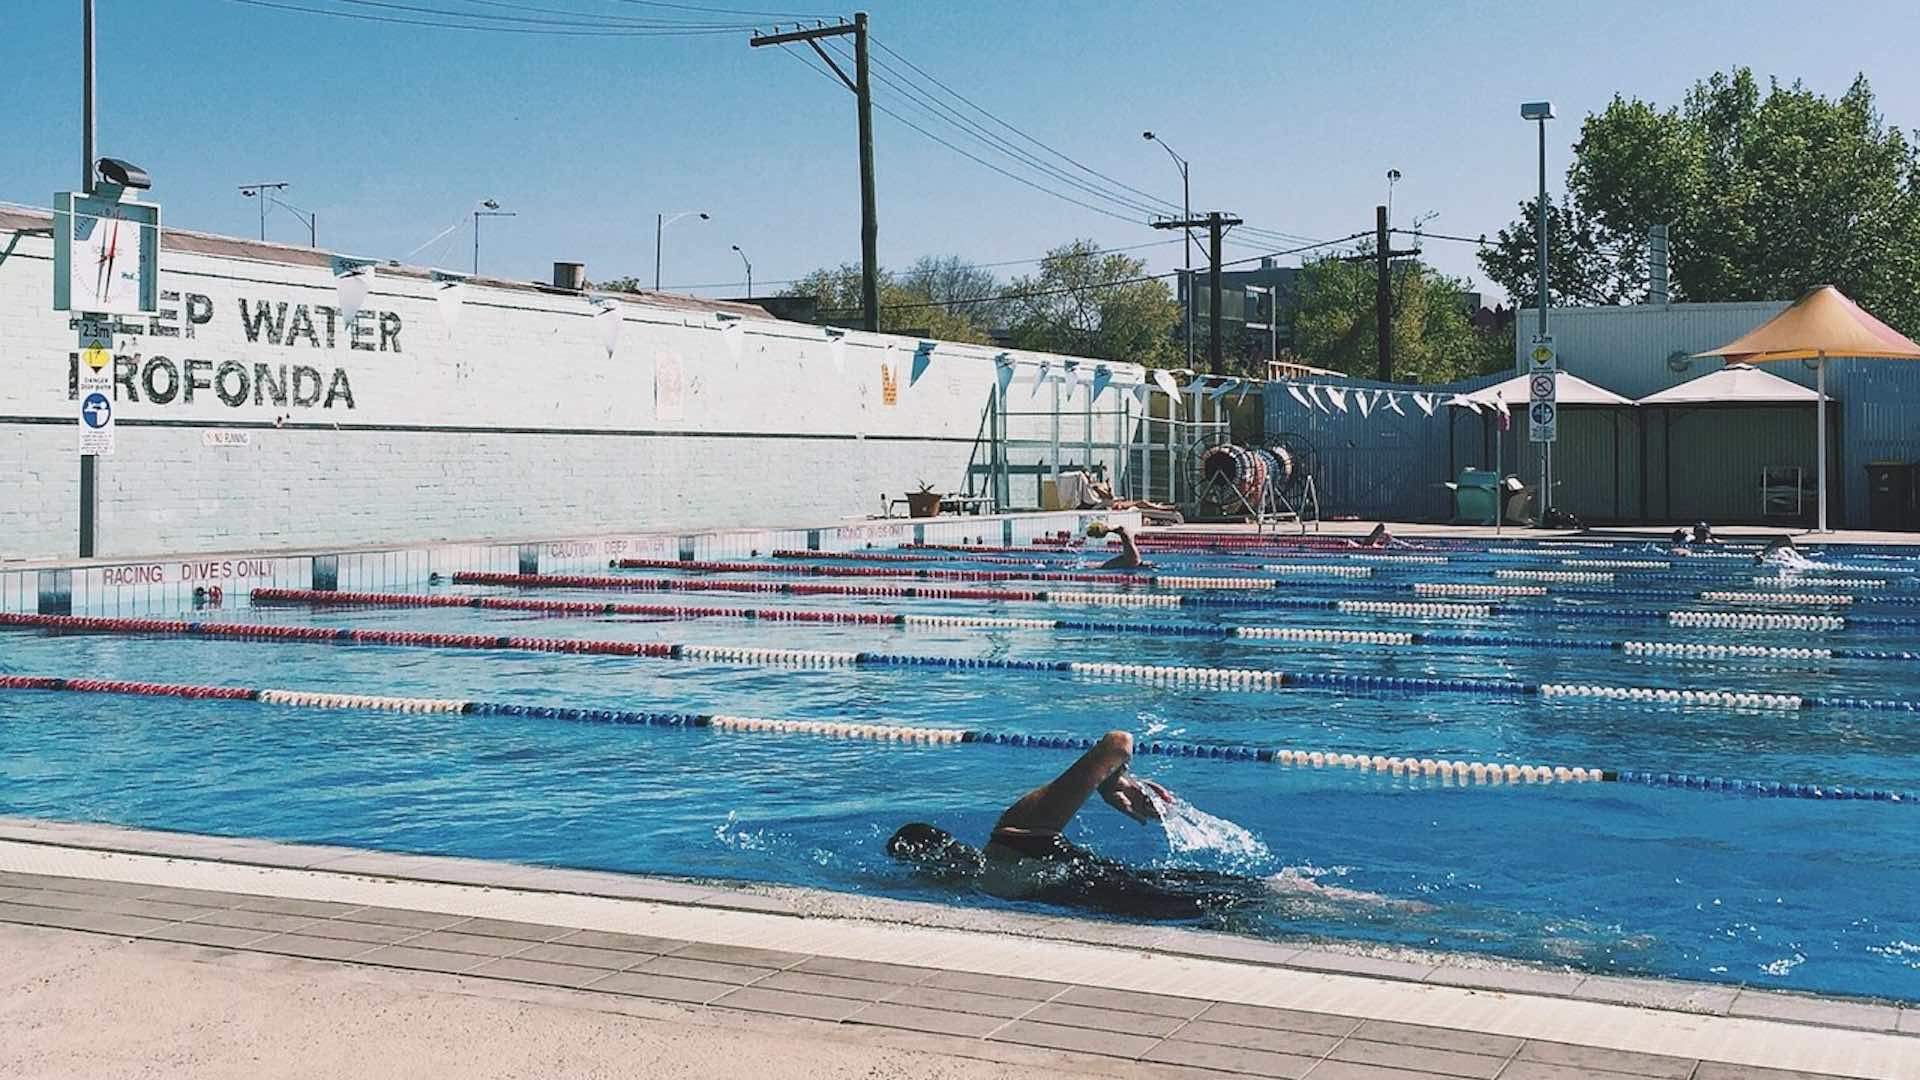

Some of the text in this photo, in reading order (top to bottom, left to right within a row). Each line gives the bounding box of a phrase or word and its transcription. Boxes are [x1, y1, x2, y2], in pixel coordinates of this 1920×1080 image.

[238, 297, 402, 352] WATER
[551, 543, 597, 558] CAUTION
[604, 540, 628, 554] DEEP
[103, 560, 273, 585] RACING DIVES ONLY
